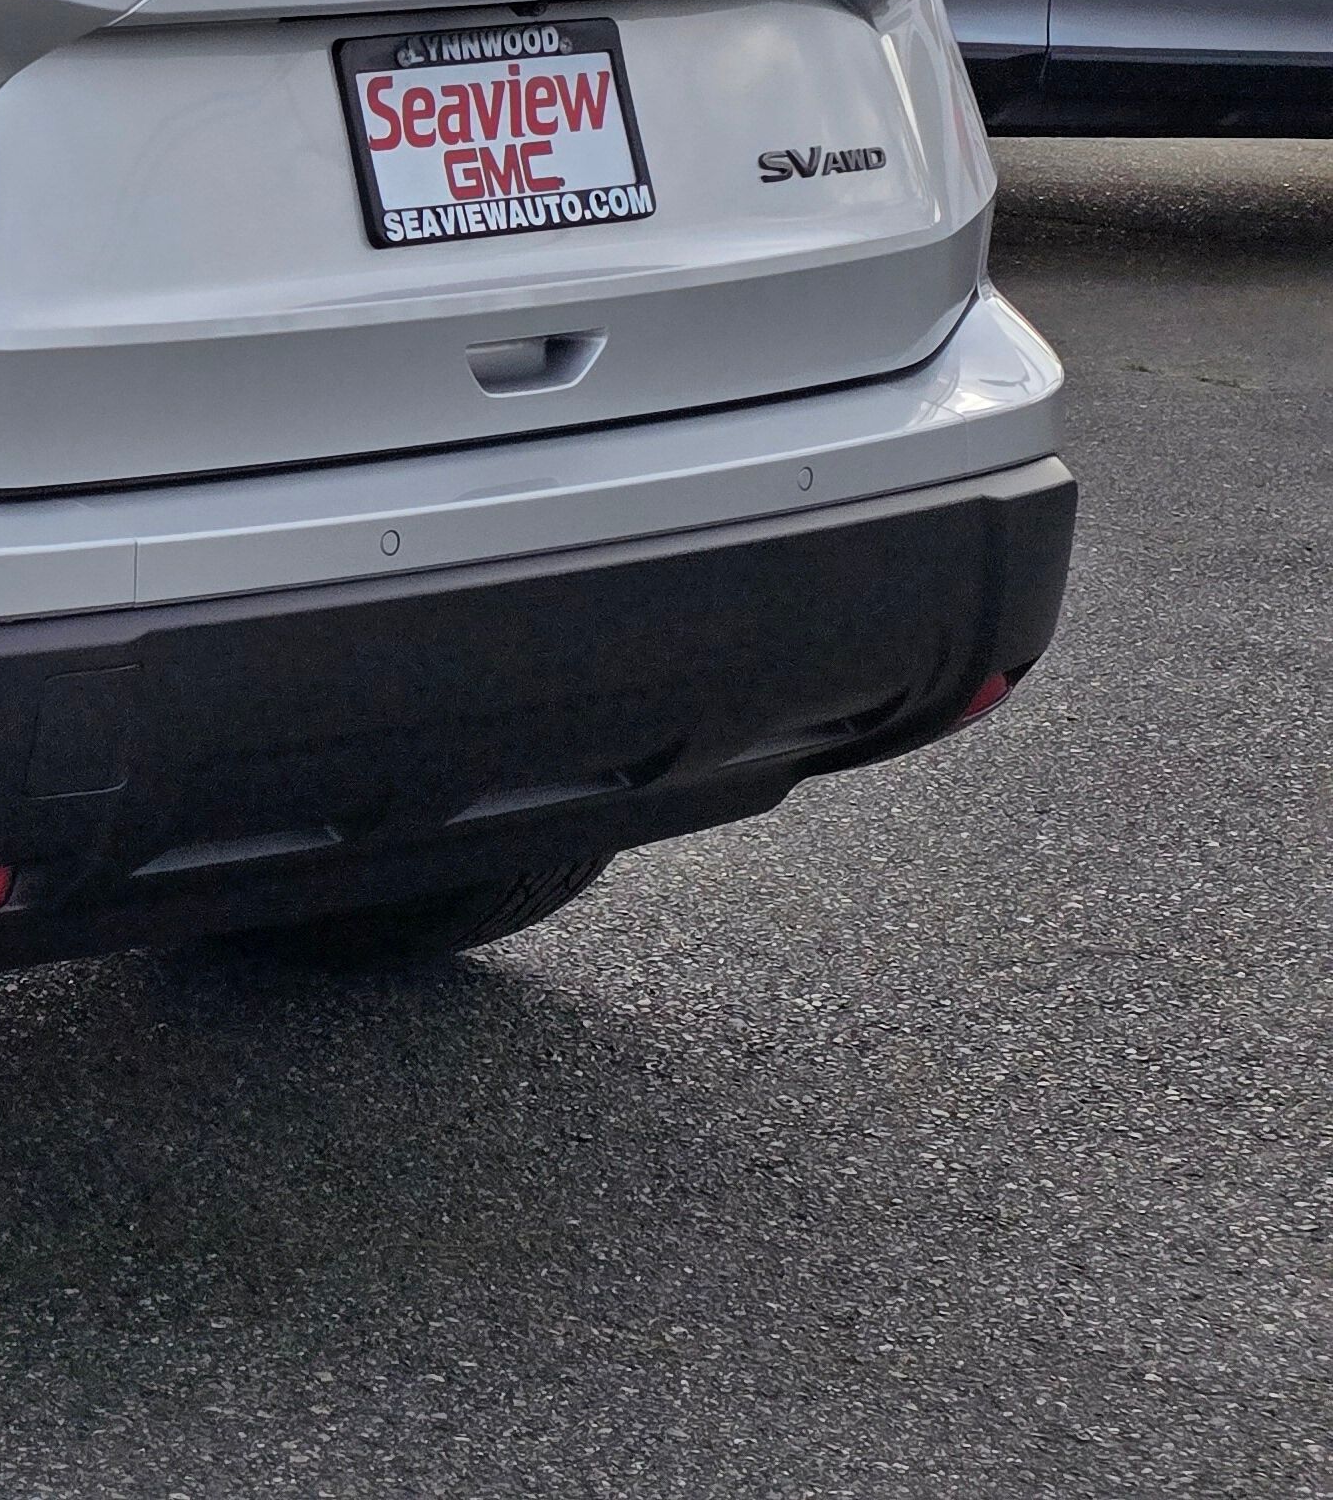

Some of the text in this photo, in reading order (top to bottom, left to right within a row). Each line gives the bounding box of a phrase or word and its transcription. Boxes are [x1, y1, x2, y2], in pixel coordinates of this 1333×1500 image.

[406, 26, 560, 64] LYNNWOOD
[366, 63, 611, 152] Seaview
[444, 140, 565, 201] GMC
[383, 184, 655, 243] SEAVIEWAUTO.COM
